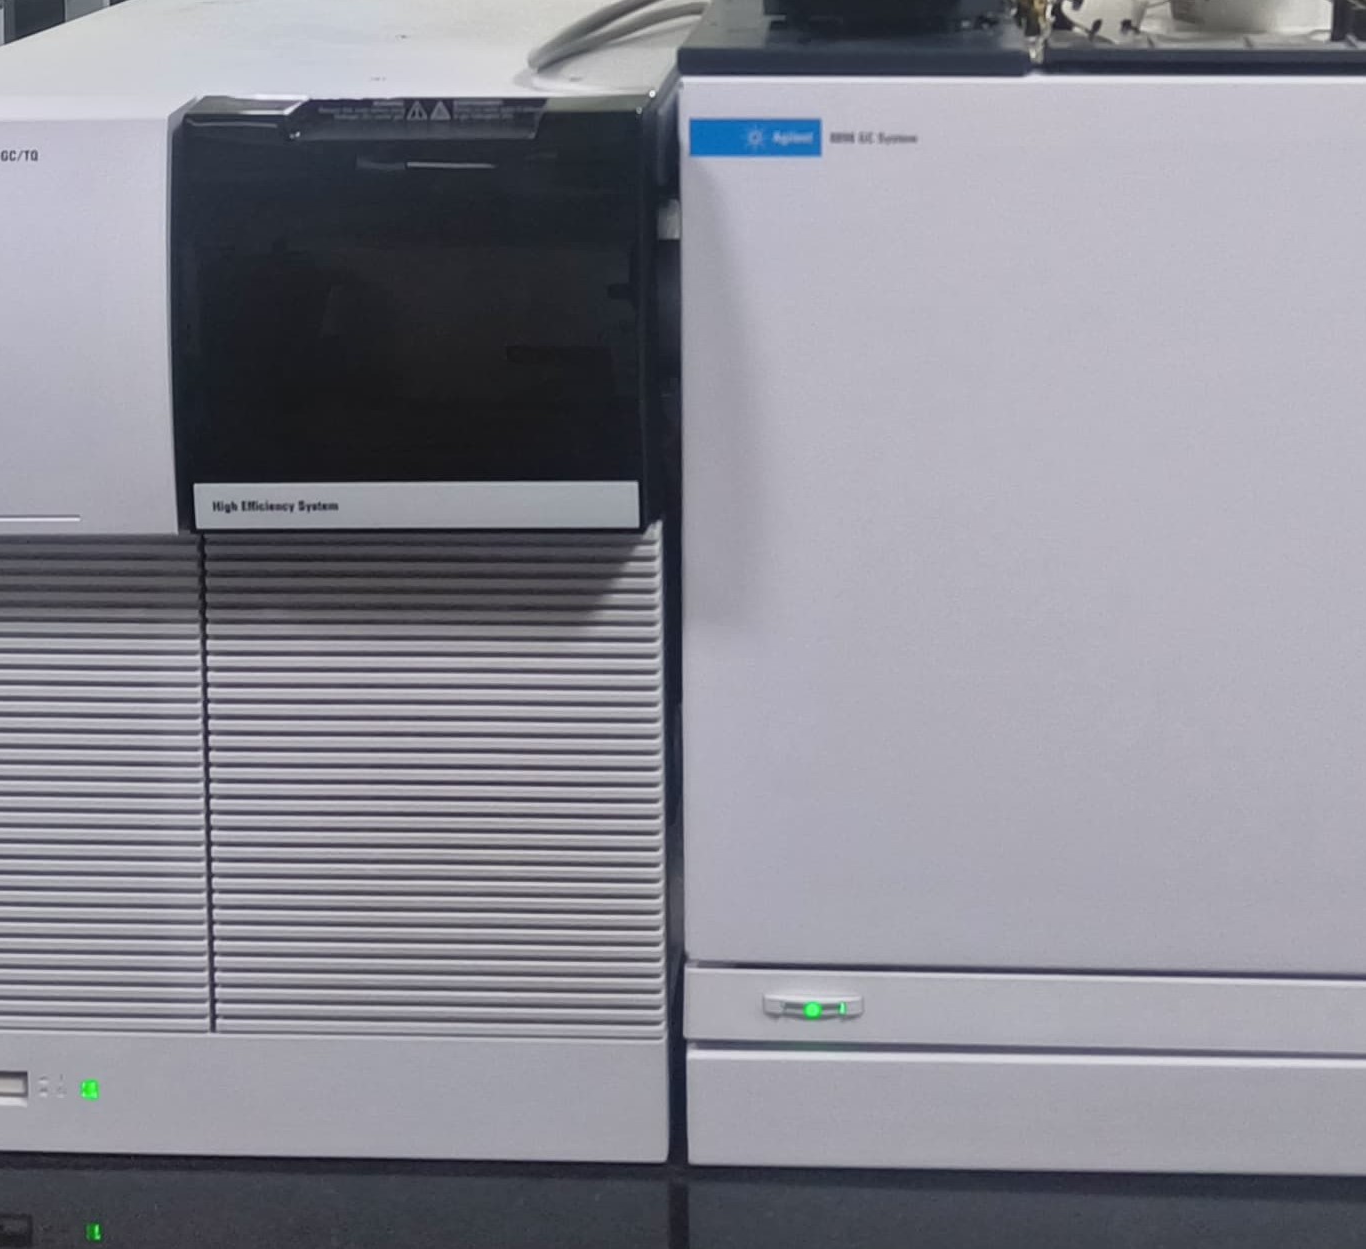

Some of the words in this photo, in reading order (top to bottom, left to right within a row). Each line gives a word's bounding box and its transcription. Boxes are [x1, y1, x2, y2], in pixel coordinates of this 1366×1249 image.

[772, 131, 814, 145] Agilent
[0, 150, 39, 163] GC/TQ
[212, 500, 239, 514] High
[241, 500, 295, 513] Efficiency
[298, 500, 339, 513] System
